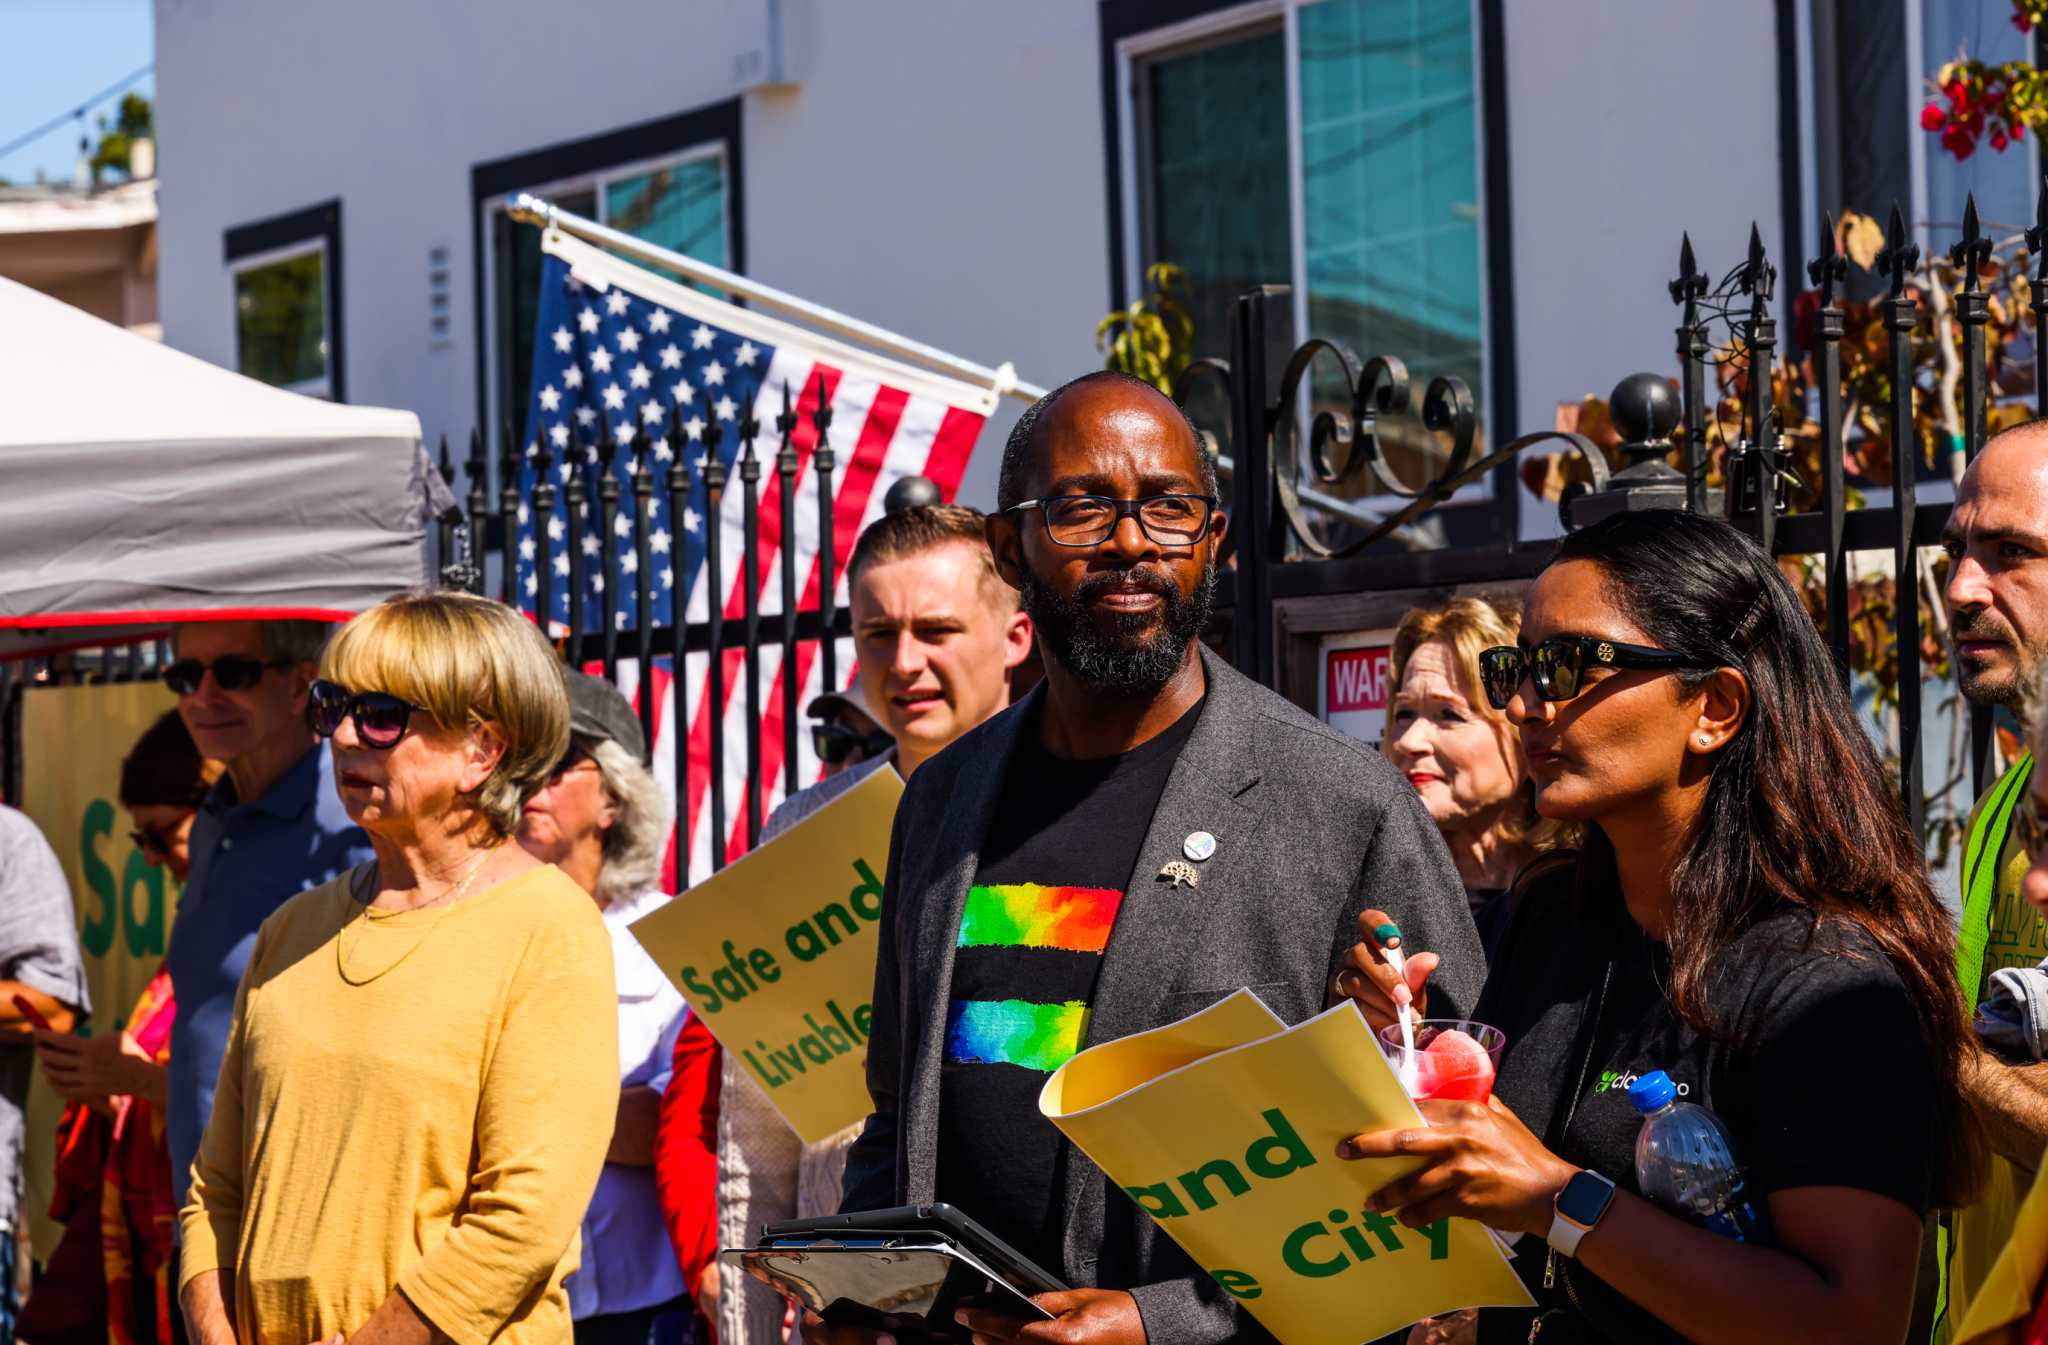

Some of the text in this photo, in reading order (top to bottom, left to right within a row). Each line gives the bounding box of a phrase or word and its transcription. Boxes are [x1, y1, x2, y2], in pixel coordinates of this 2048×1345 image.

[79, 797, 166, 960] Sa
[681, 857, 883, 1014] Safe and
[742, 999, 873, 1089] Livable
[1123, 1107, 1318, 1220] and
[1282, 1208, 1449, 1279] City
